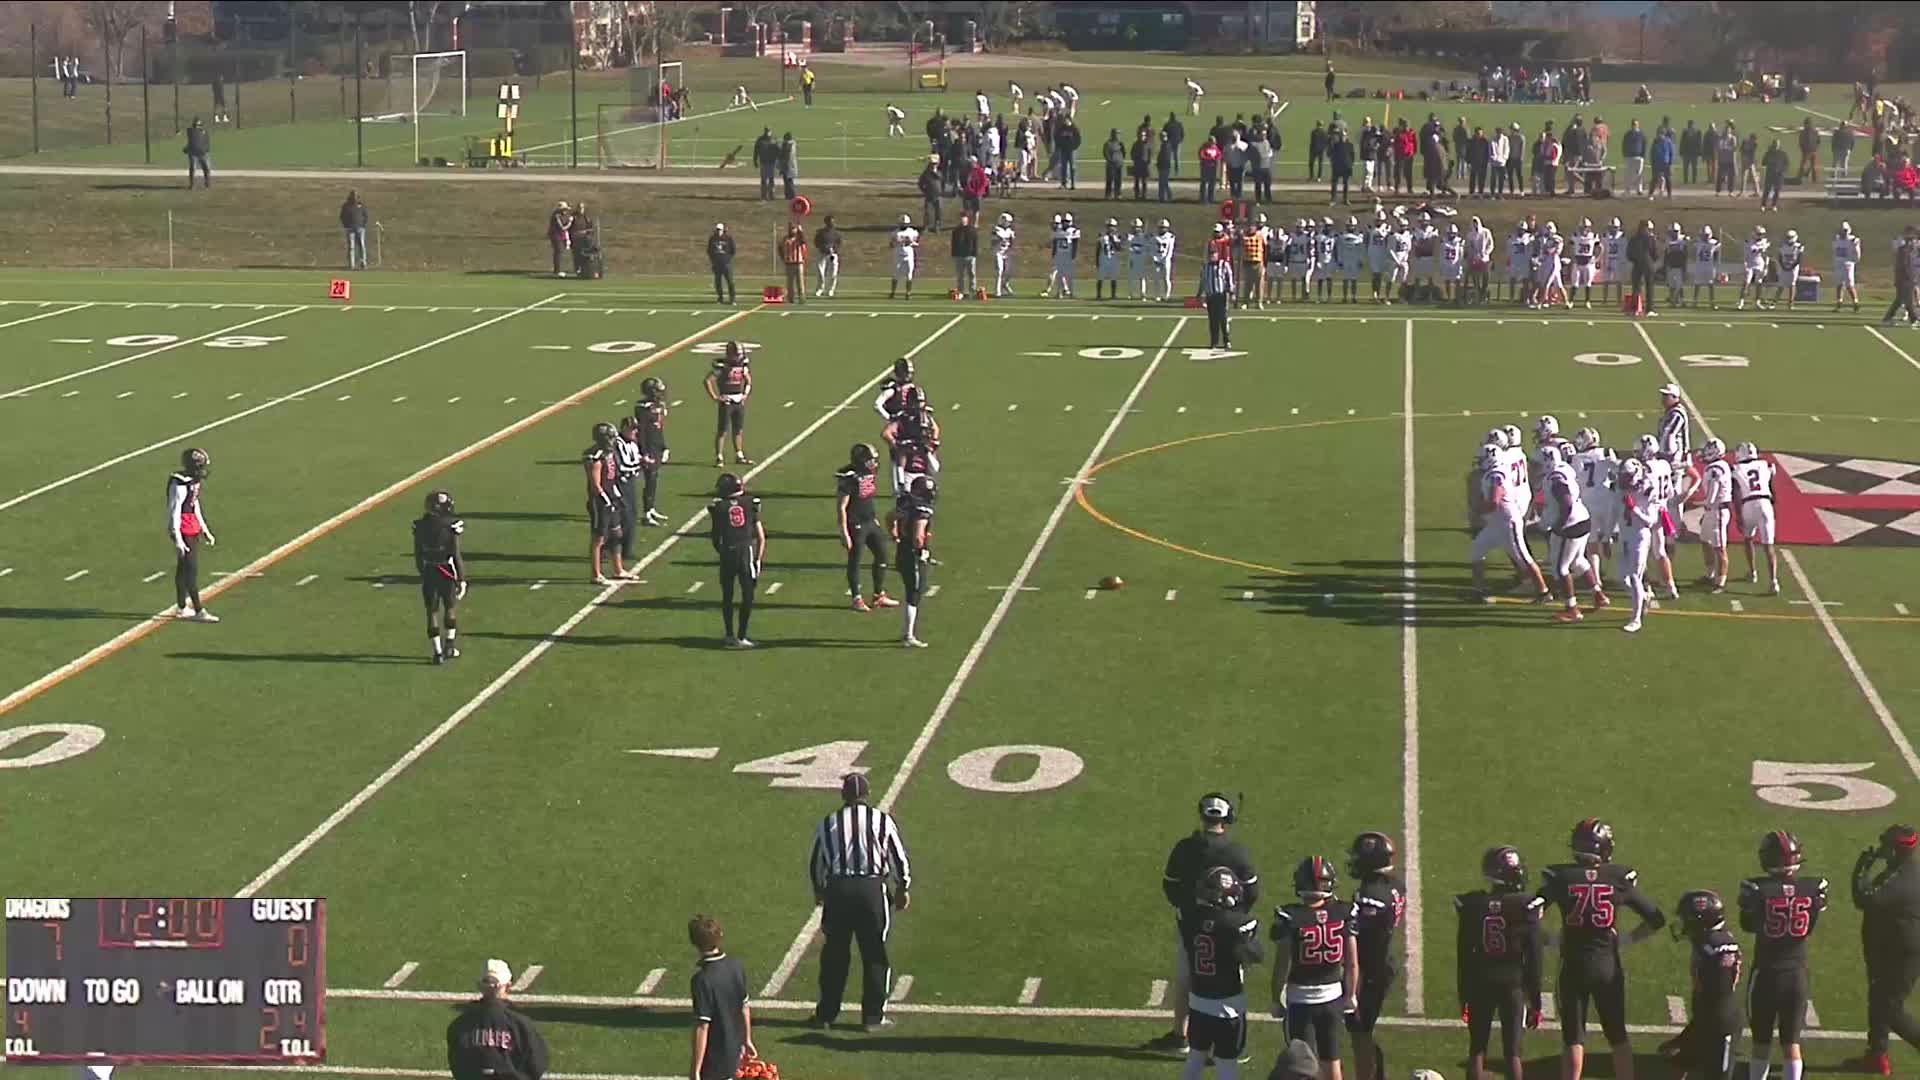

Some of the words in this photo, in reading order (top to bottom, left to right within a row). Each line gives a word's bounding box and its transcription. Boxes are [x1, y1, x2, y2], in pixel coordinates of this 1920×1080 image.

[1583, 461, 1595, 487] 7
[1658, 475, 1669, 500] 12
[1747, 469, 1761, 491] 2
[1751, 760, 1897, 811] 5
[1567, 884, 1614, 928] 75
[1763, 897, 1812, 938] 56
[1300, 920, 1345, 964] 25
[1483, 914, 1506, 954] 6
[1194, 935, 1217, 976] 2
